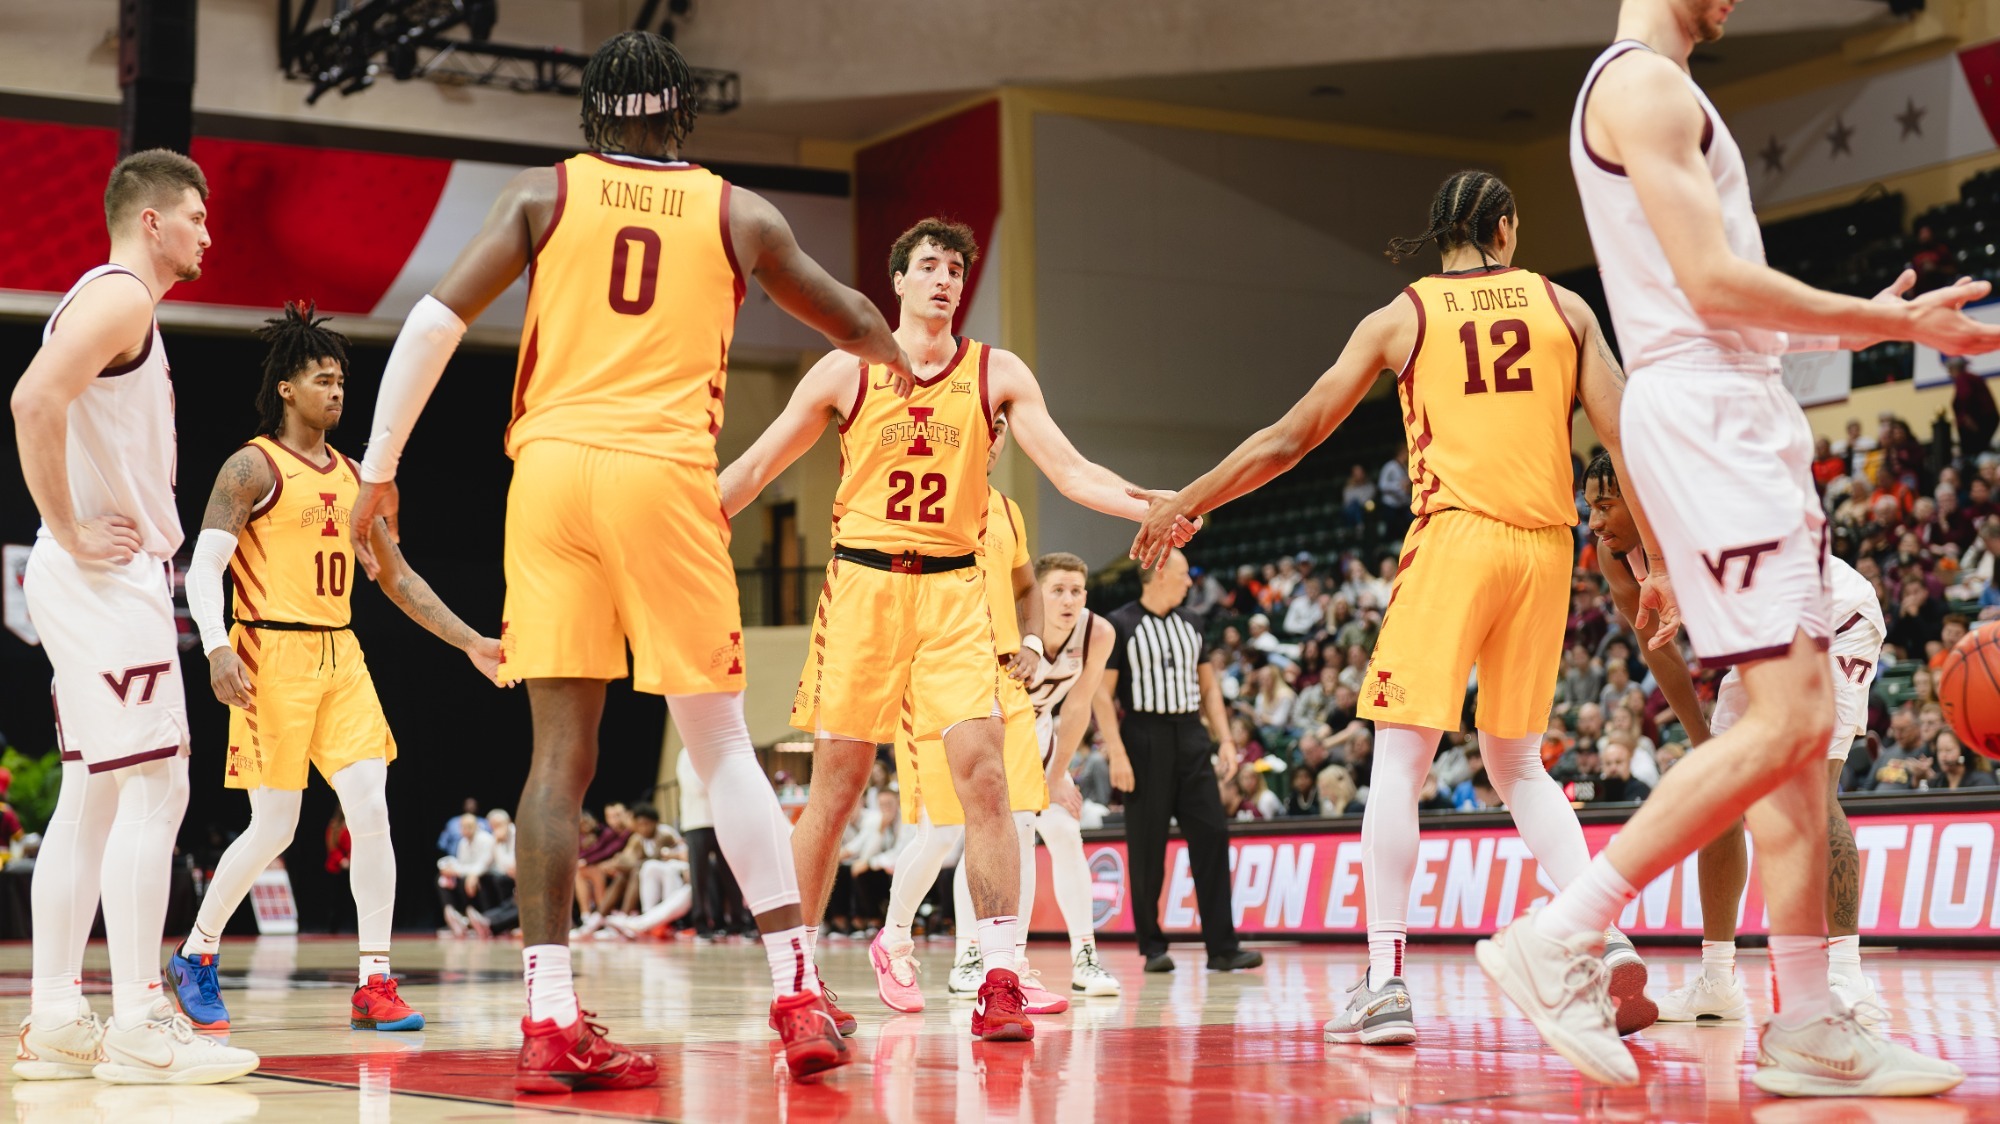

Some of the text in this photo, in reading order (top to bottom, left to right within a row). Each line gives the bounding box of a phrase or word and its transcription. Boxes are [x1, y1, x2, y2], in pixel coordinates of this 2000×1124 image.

[599, 178, 685, 218] KING III
[608, 225, 662, 316] 0
[1443, 286, 1529, 313] R. JONES
[1458, 318, 1534, 396] 12
[881, 420, 960, 449] STATE
[885, 470, 947, 524] 22
[314, 550, 347, 597] 10
[1697, 536, 1787, 594] VT
[97, 659, 174, 708] VT
[1835, 655, 1873, 686] VT
[1163, 842, 1316, 929] EPN
